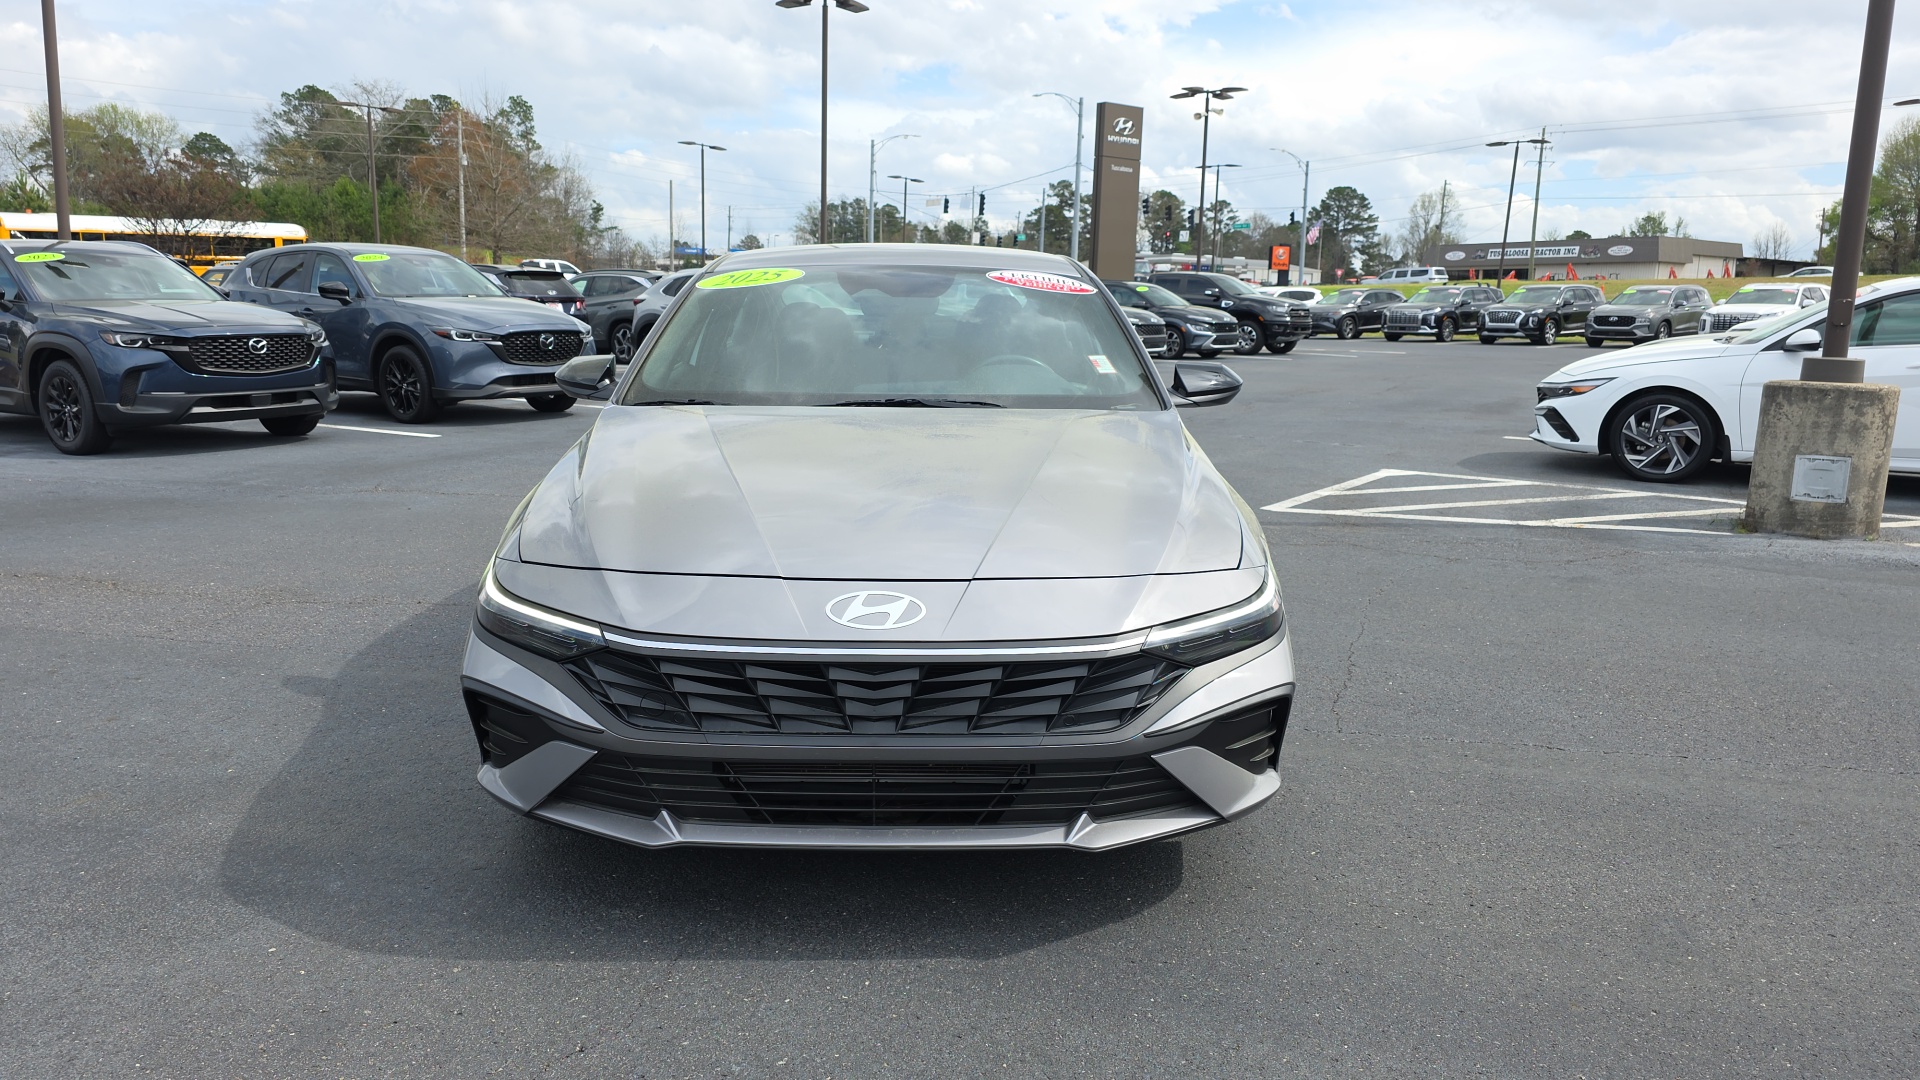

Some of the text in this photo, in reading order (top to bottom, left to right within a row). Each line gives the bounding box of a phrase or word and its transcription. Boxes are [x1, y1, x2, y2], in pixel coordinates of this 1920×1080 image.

[1107, 134, 1139, 145] HYUNDAI
[1489, 247, 1577, 258] TUSALOOSA RACTOR INC.
[711, 269, 789, 287] 2025
[999, 271, 1083, 288] CERTIFIED
